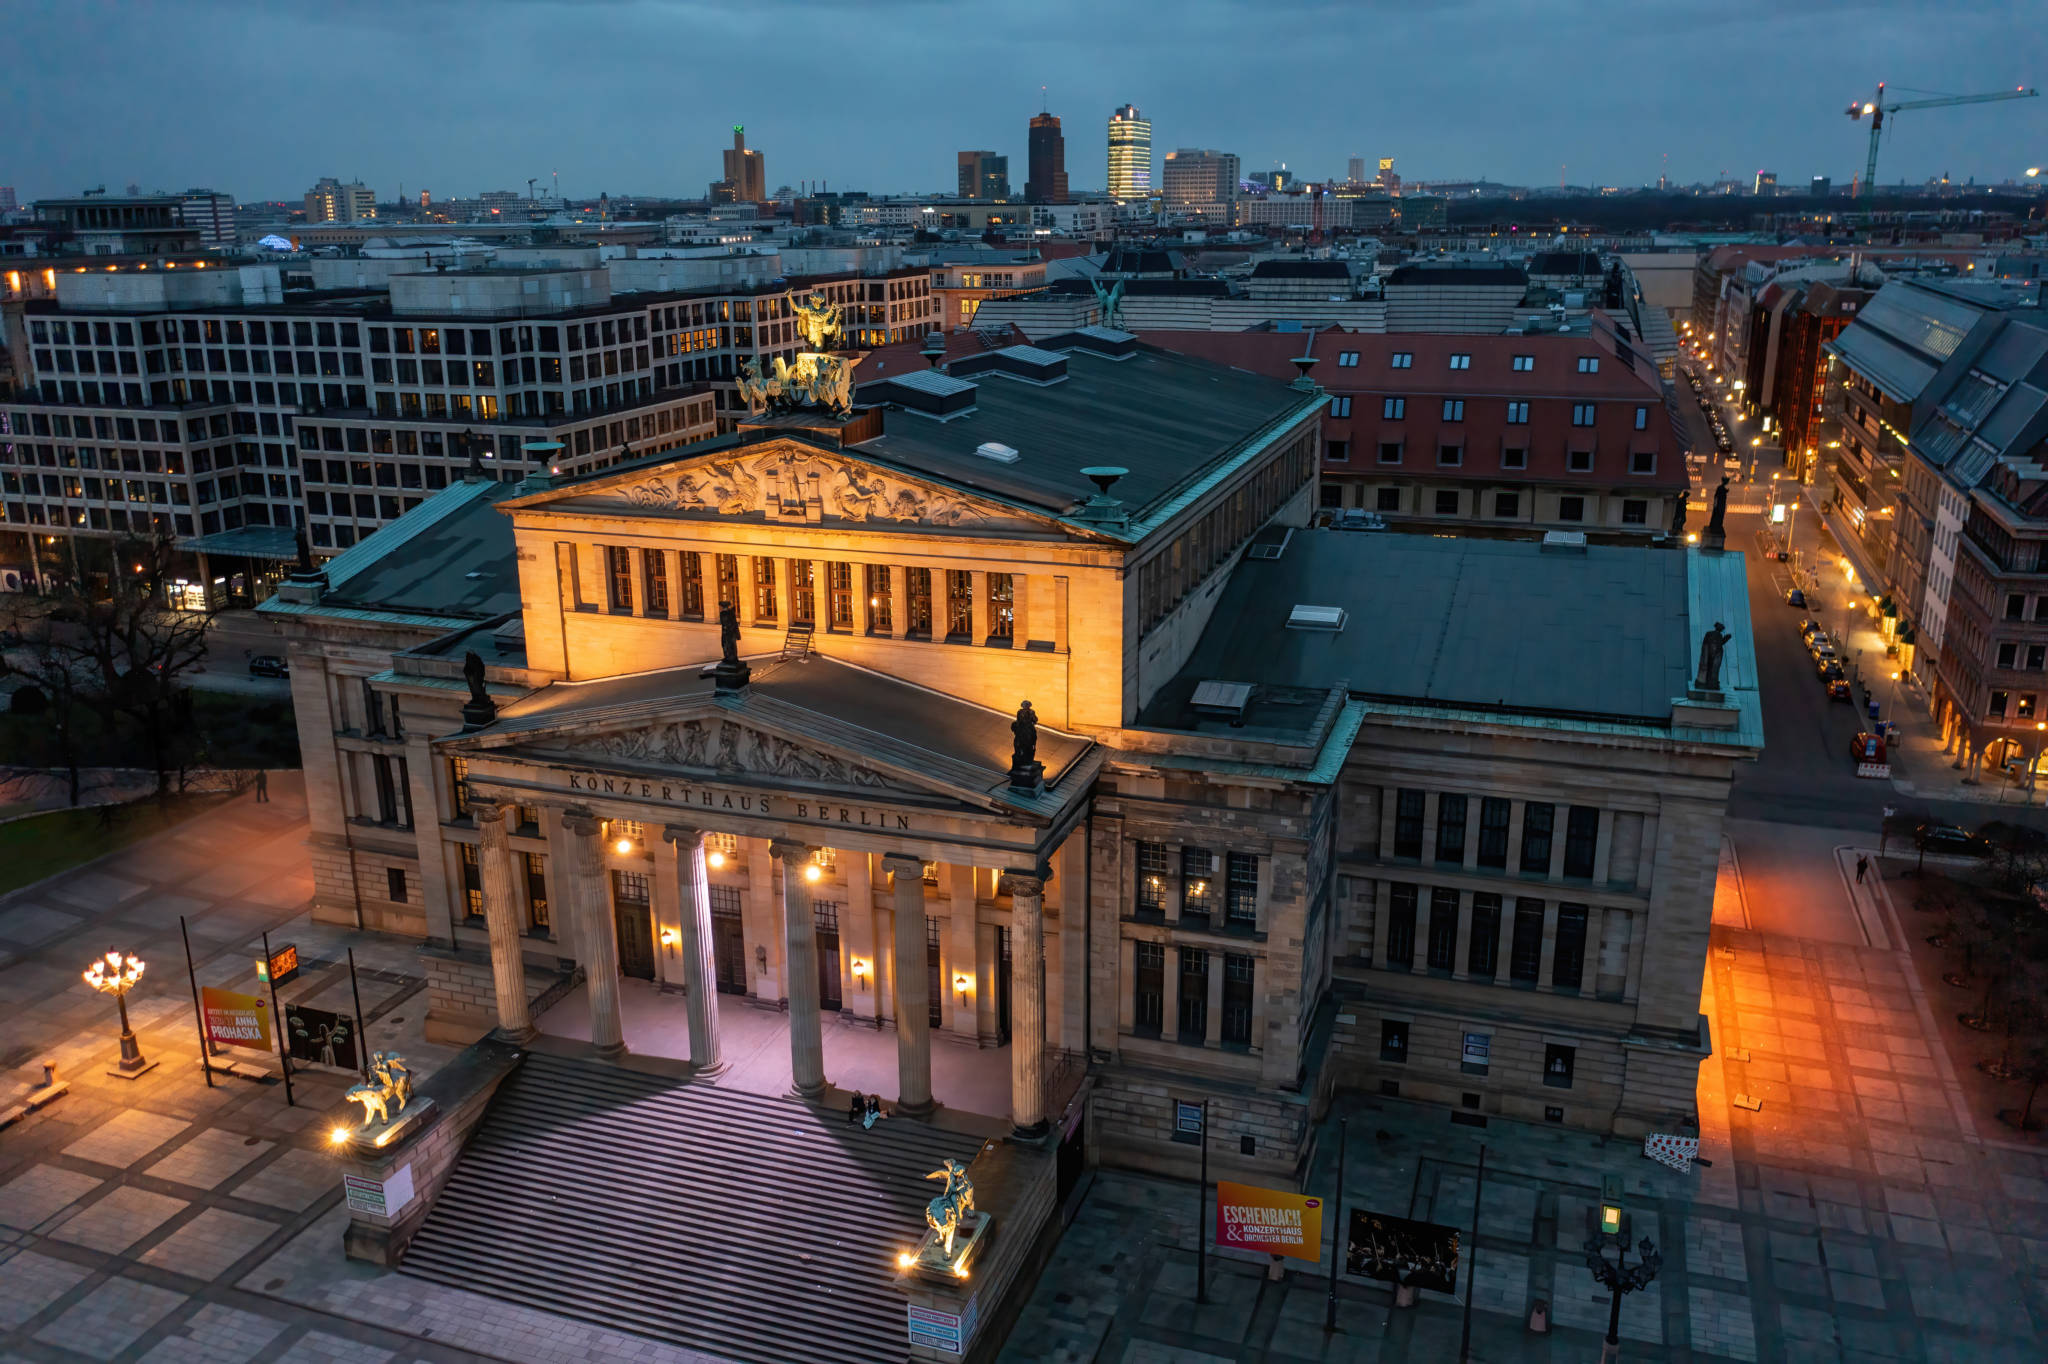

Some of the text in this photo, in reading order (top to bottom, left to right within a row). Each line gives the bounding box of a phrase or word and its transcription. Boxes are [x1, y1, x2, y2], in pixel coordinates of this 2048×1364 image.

[569, 774, 910, 831] KONZERTHAUS BERLIN
[235, 1016, 259, 1026] ANNA
[210, 1025, 263, 1040] PROHASKA
[1223, 1206, 1302, 1226] ESCHENBACH
[1243, 1225, 1303, 1236] KONZERTHAUS
[1244, 1233, 1304, 1245] ORCHESTER BERLIN
